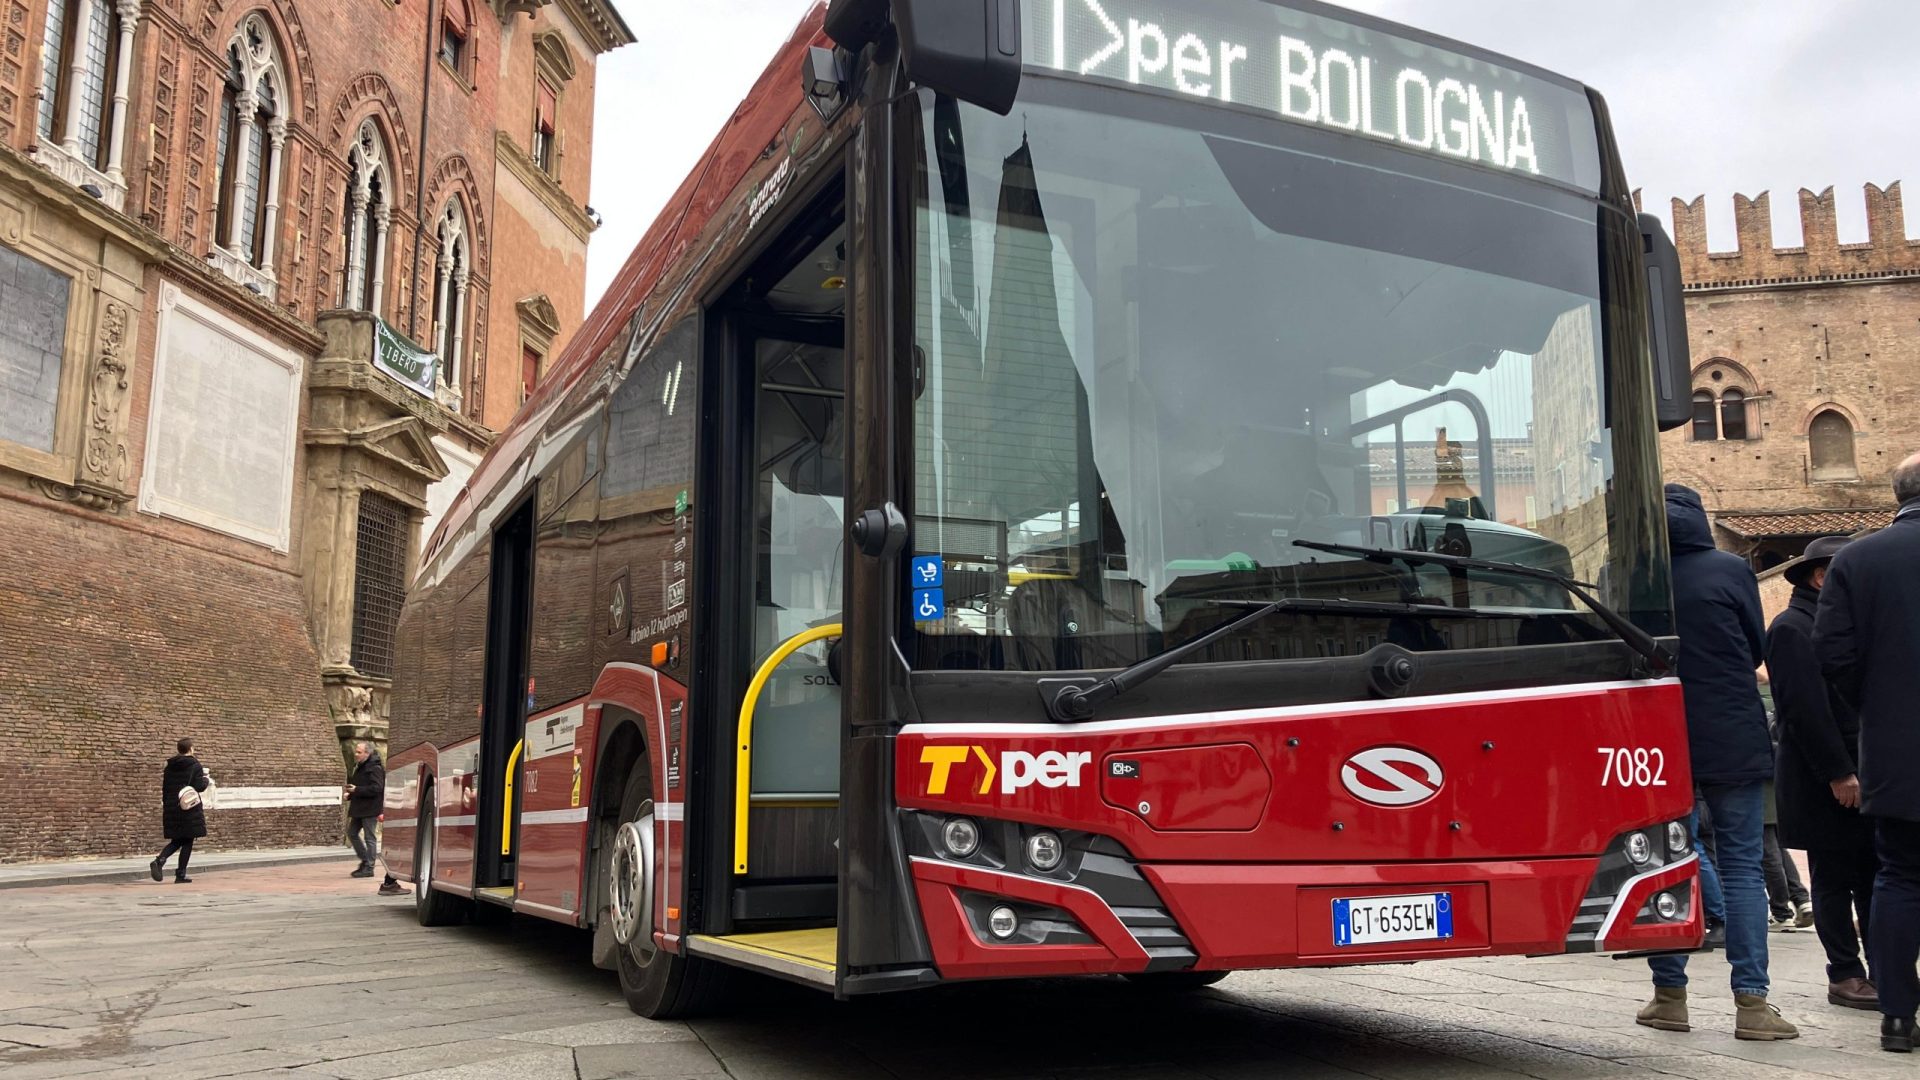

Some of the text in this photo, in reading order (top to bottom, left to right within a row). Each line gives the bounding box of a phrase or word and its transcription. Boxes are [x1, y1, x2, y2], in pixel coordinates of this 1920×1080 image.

[1279, 34, 1541, 175] BOLOGNA
[749, 155, 790, 216] entrata
[380, 342, 416, 373] LIBERO
[657, 609, 688, 633] hydrogen
[1597, 747, 1667, 787] 7082
[1351, 907, 1373, 935] GT
